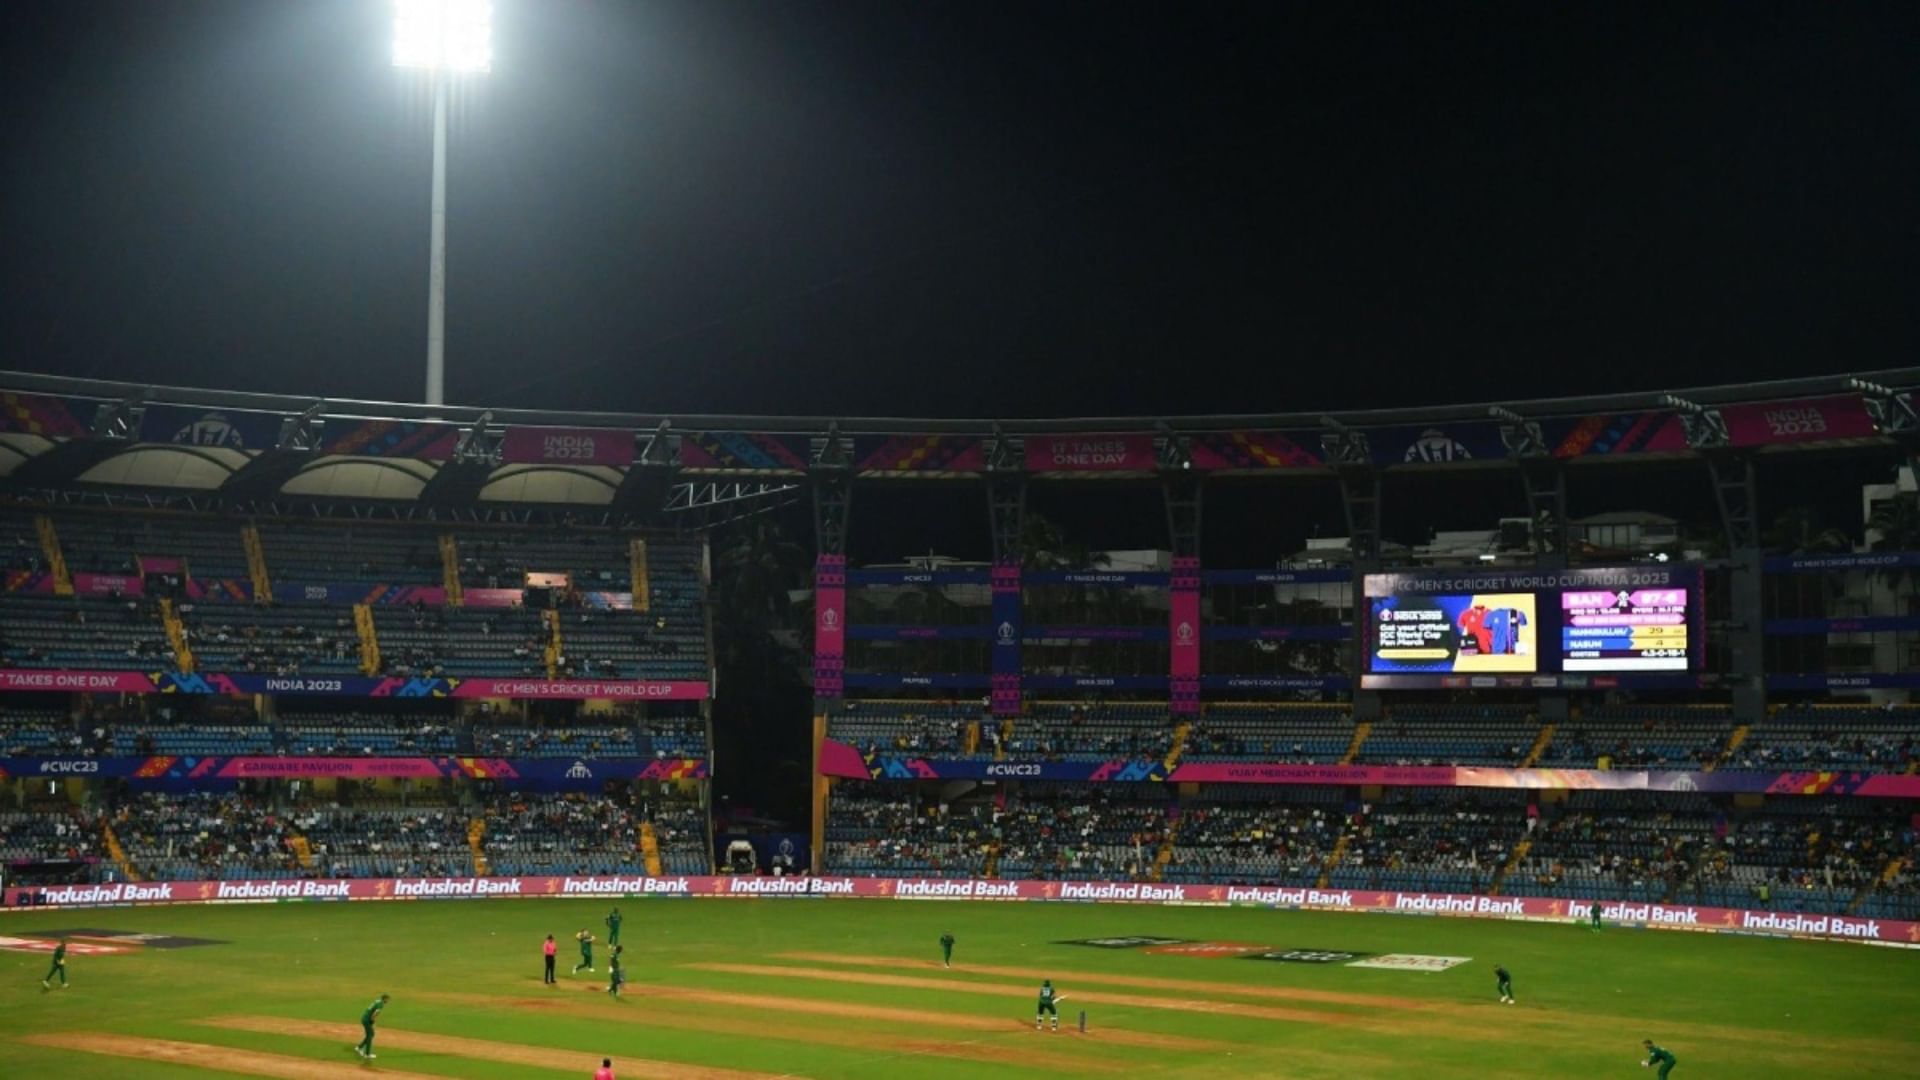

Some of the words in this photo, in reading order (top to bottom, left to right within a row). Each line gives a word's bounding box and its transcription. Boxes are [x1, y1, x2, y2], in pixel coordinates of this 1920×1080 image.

[1765, 408, 1823, 422] INDIA
[1769, 420, 1826, 435] 2023
[544, 435, 594, 448] INDIA
[1051, 442, 1066, 453] IT
[1071, 441, 1126, 452] TAKES
[543, 448, 594, 459] 2023
[1053, 453, 1088, 465] ONE
[1092, 453, 1127, 464] DAY
[1415, 580, 1451, 591] MEN'S
[1454, 577, 1506, 590] CRICKET
[1510, 576, 1556, 589] WORLD
[1559, 575, 1585, 587] CUP
[1589, 574, 1629, 586] INDIA
[1632, 573, 1670, 585] 2023
[7, 674, 53, 686] TAKES
[56, 675, 86, 686] ONE
[89, 676, 118, 687] DAY
[266, 679, 304, 690] INDIA
[307, 680, 341, 691] 2023
[493, 683, 511, 694] ICC
[513, 683, 548, 694] MEN'S
[550, 683, 600, 695] CRICKET
[603, 684, 645, 695] WORLD
[648, 685, 672, 695] CUP
[40, 761, 98, 773] #CWC23
[302, 762, 352, 773] PAVILION
[986, 764, 1041, 776] #CWC23
[1260, 768, 1317, 779] MERCHANT
[1319, 769, 1368, 779] PAVILION
[124, 883, 171, 899] Bank
[218, 881, 301, 897] IndusInd
[303, 881, 350, 896] Bank
[394, 879, 474, 895] IndusInd
[476, 878, 521, 893] Bank
[563, 877, 642, 892] IndusInd
[644, 878, 688, 891] Bank
[731, 877, 809, 893] IndusInd
[811, 878, 853, 893] Bank
[896, 880, 973, 896] IndusInd
[975, 881, 1018, 896] Bank
[1060, 882, 1138, 899] IndusInd
[1140, 884, 1184, 900] Bank
[1227, 886, 1307, 904] IndusInd
[1308, 889, 1352, 906] Bank
[1395, 893, 1476, 912] IndusInd
[1478, 896, 1524, 914] Bank
[1651, 903, 1698, 922] Bank
[1743, 911, 1828, 931] IndusInd
[1830, 916, 1880, 937] Bank
